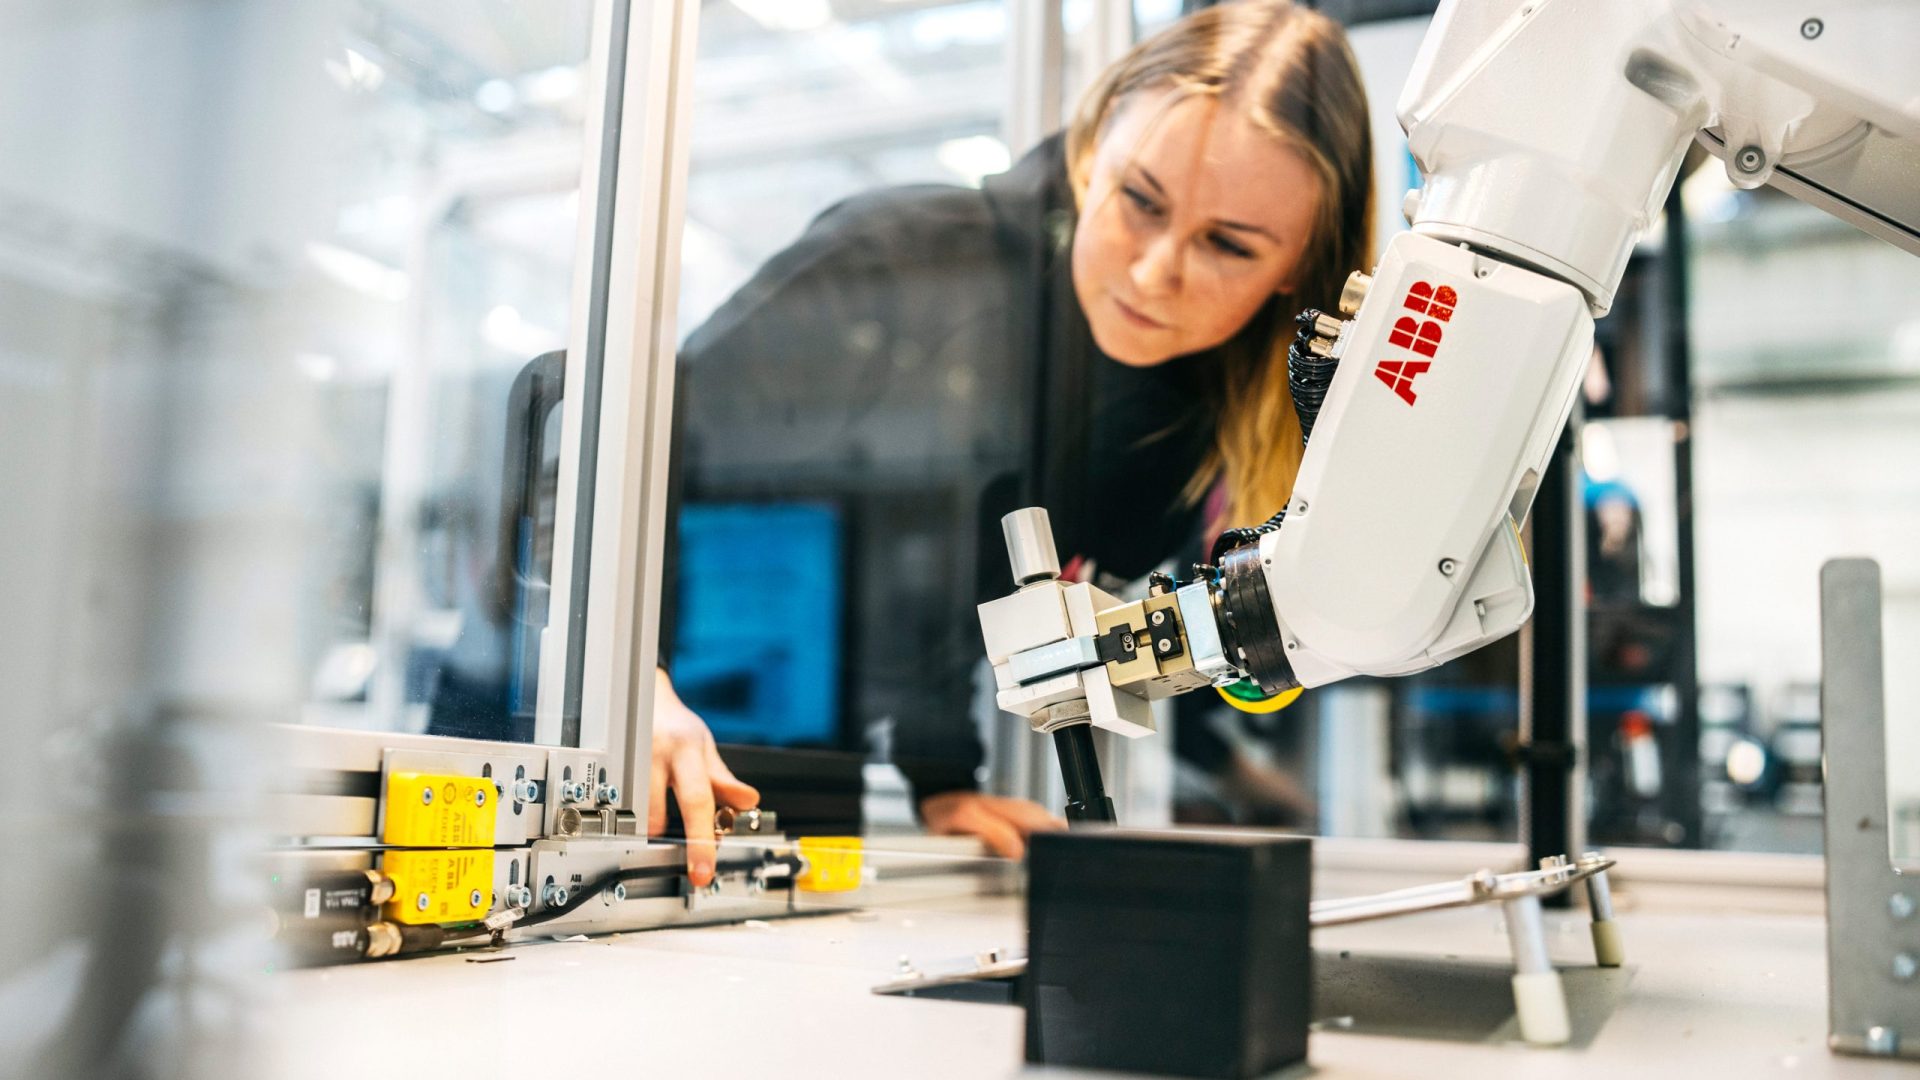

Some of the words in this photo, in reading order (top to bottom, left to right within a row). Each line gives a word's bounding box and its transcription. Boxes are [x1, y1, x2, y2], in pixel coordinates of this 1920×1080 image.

[1374, 280, 1458, 407] ABB
[453, 812, 461, 843] ABB
[446, 858, 455, 890] ABB
[570, 874, 582, 882] ABB
[332, 930, 358, 949] ABB
